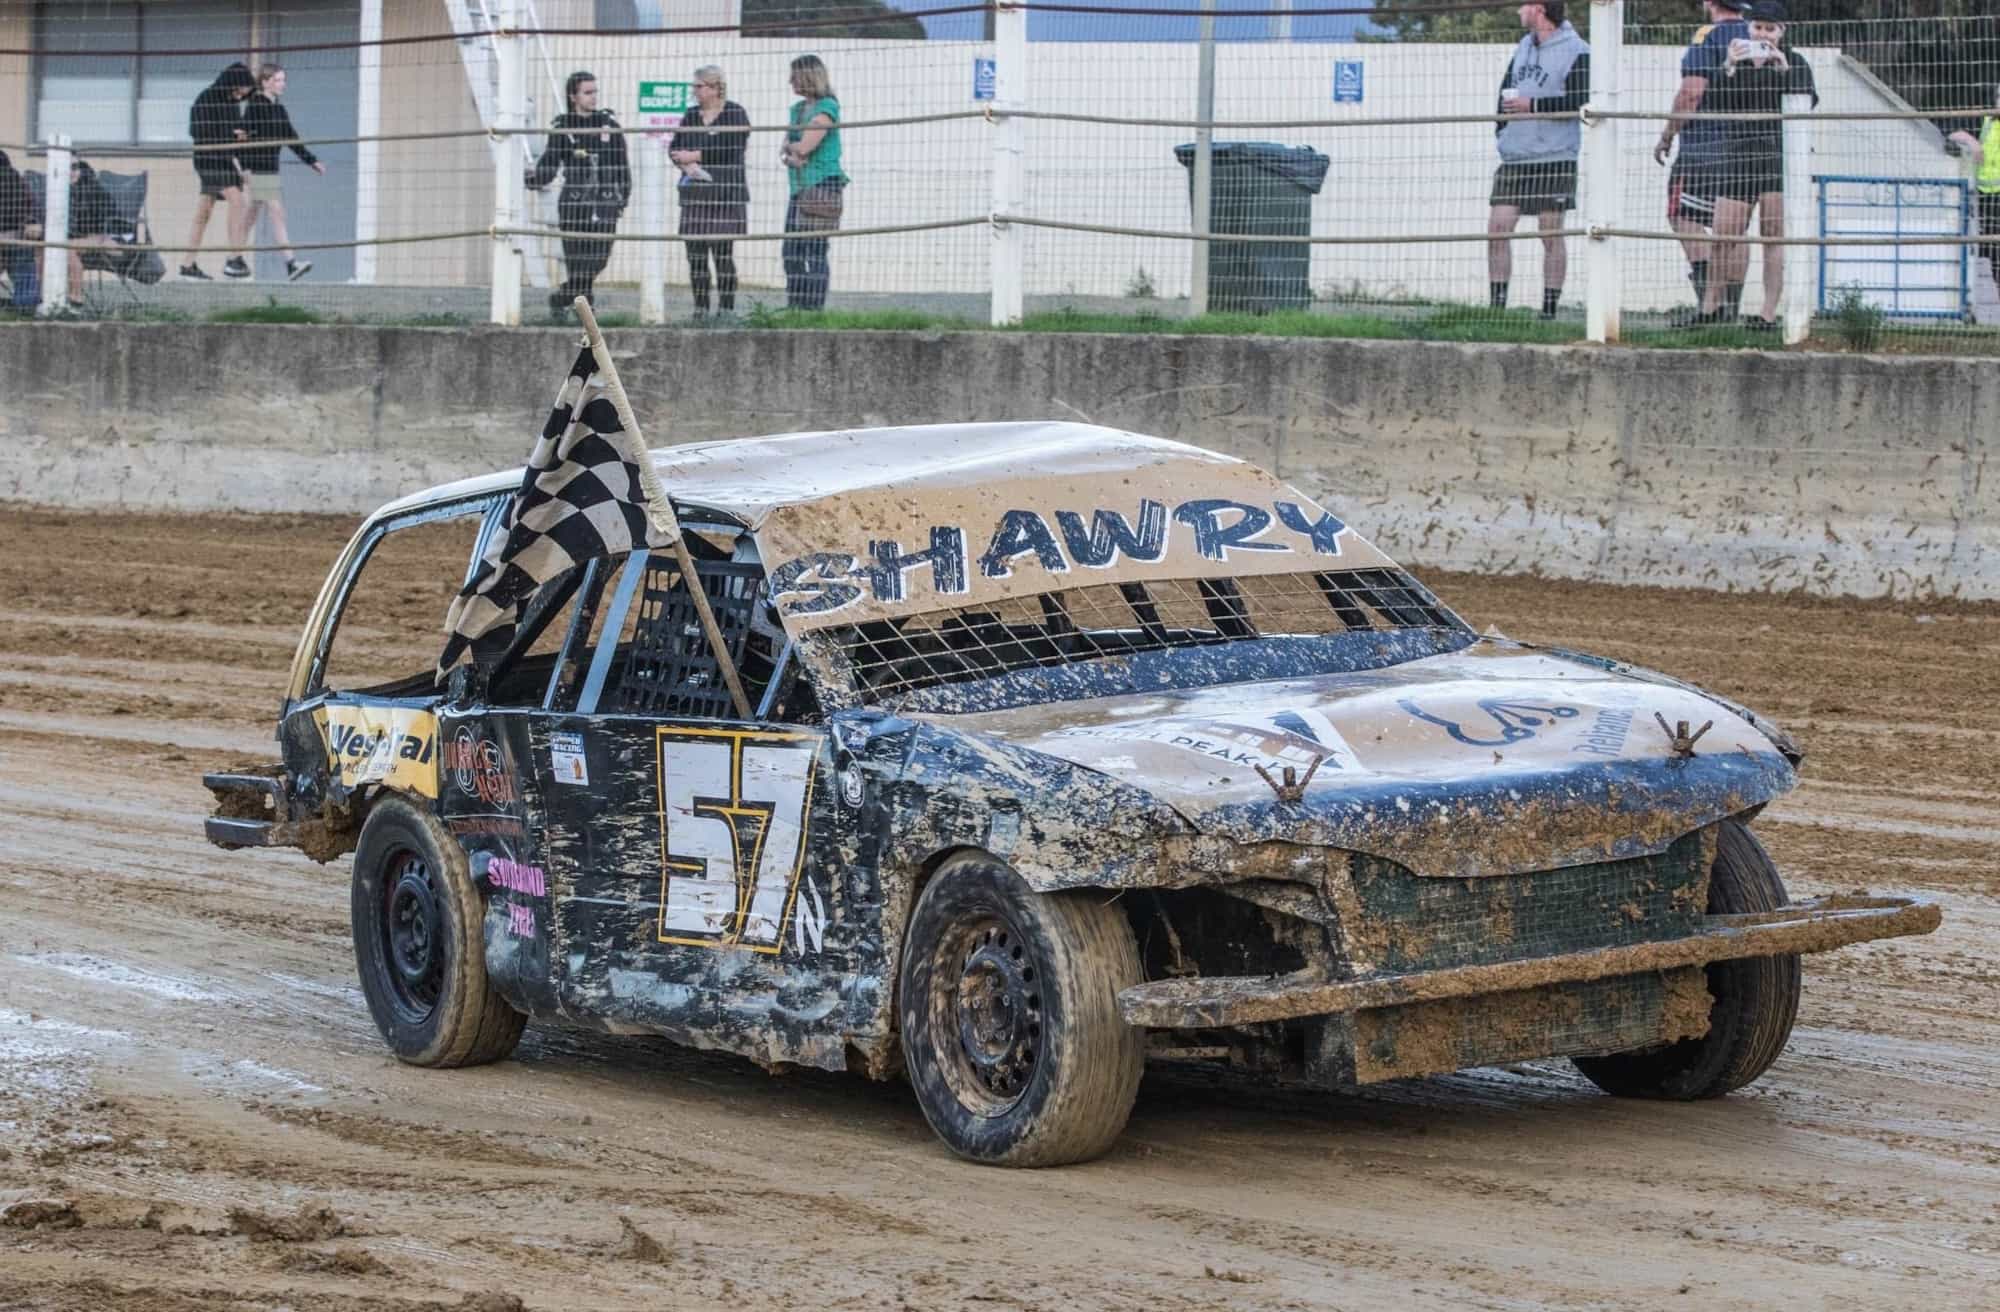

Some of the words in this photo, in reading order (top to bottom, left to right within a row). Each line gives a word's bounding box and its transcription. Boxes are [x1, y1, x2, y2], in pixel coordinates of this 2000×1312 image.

[771, 498, 1349, 619] SHAWRY
[1169, 735, 1259, 765] PEAK
[657, 730, 822, 952] 57
